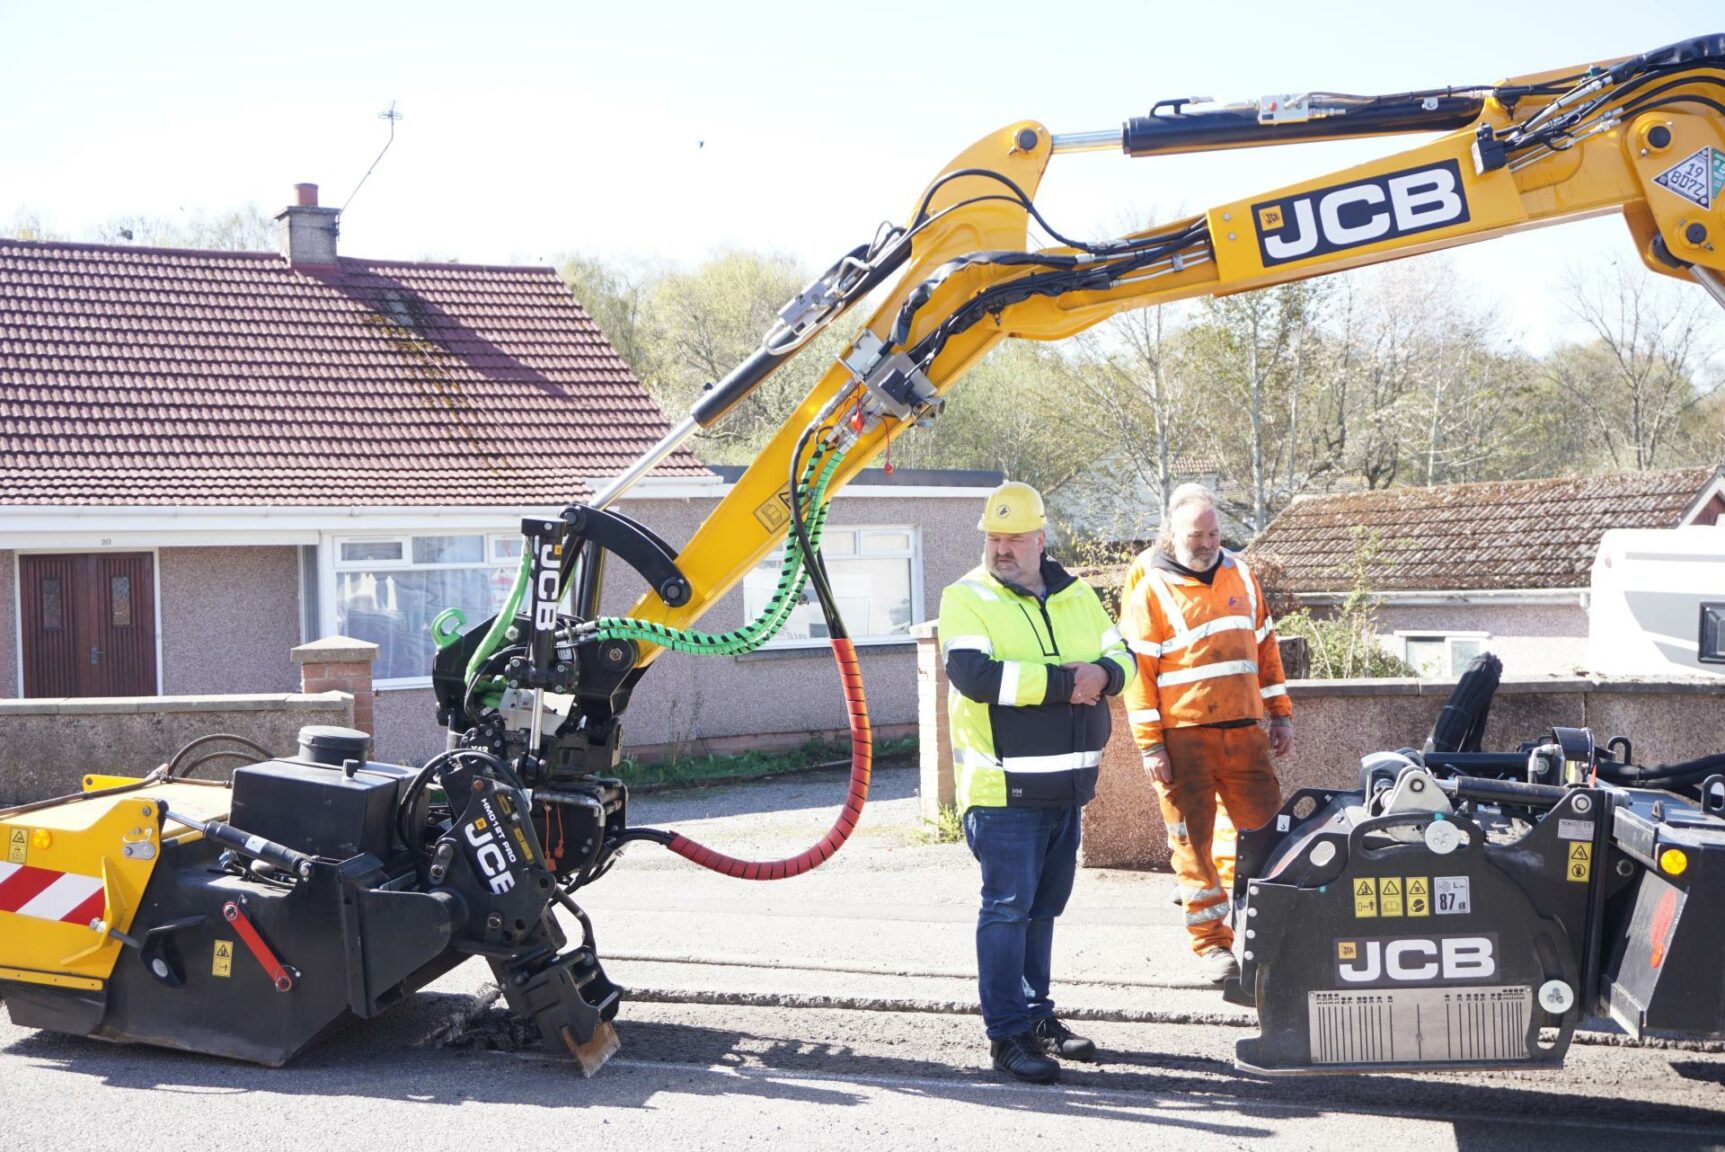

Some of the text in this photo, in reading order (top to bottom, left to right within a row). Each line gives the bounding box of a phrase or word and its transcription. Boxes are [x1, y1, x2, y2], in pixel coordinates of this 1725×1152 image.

[1685, 163, 1704, 178] 19
[1264, 168, 1462, 259] JCB
[536, 544, 561, 631] JCB
[502, 841, 517, 864] PRO
[1440, 893, 1456, 910] 87
[1339, 937, 1495, 982] JCB
